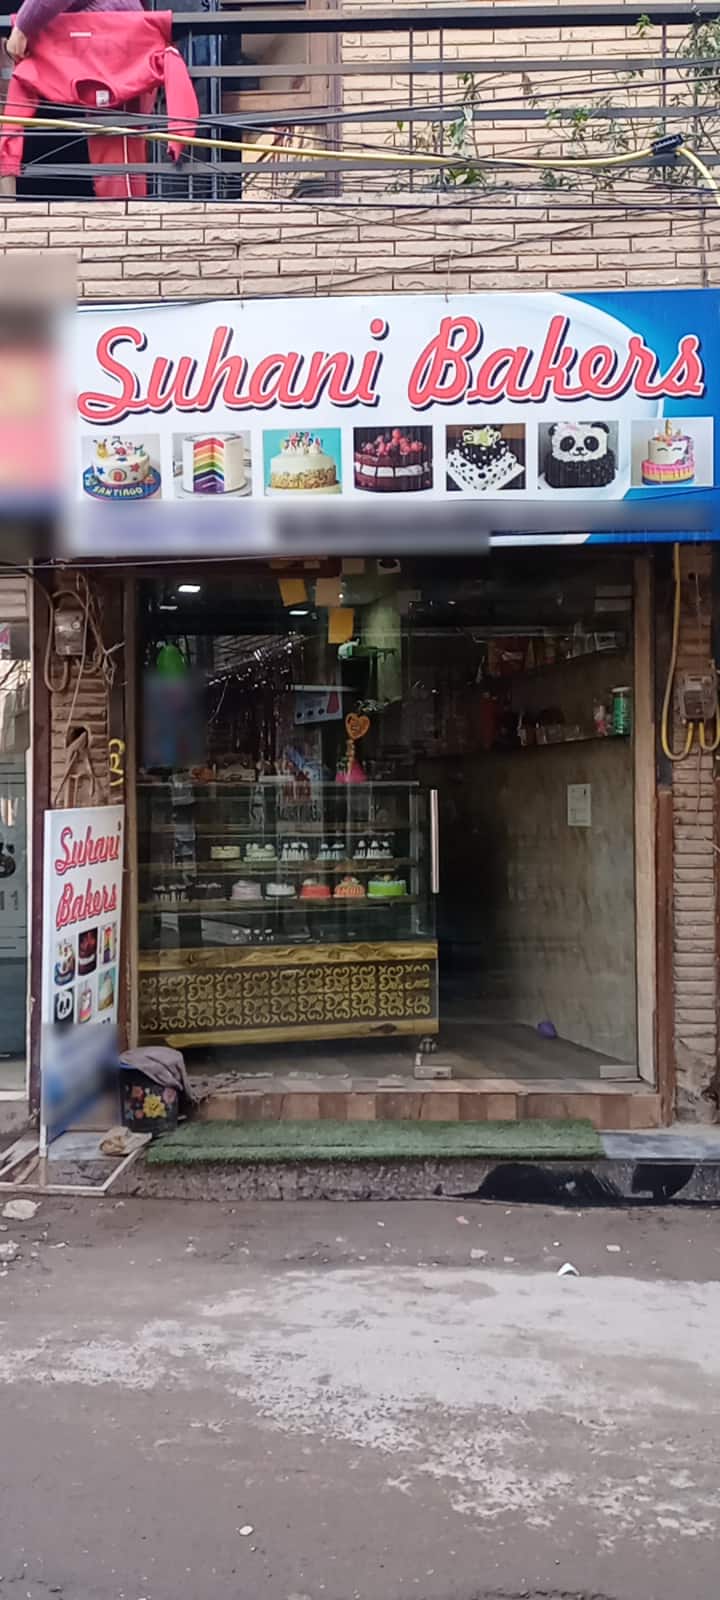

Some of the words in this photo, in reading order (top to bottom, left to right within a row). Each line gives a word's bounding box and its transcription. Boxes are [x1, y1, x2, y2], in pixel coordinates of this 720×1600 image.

[77, 318, 390, 426] Suhani
[406, 314, 706, 412] Bakers
[55, 821, 121, 876] Suhani
[56, 878, 117, 931] Bakers
